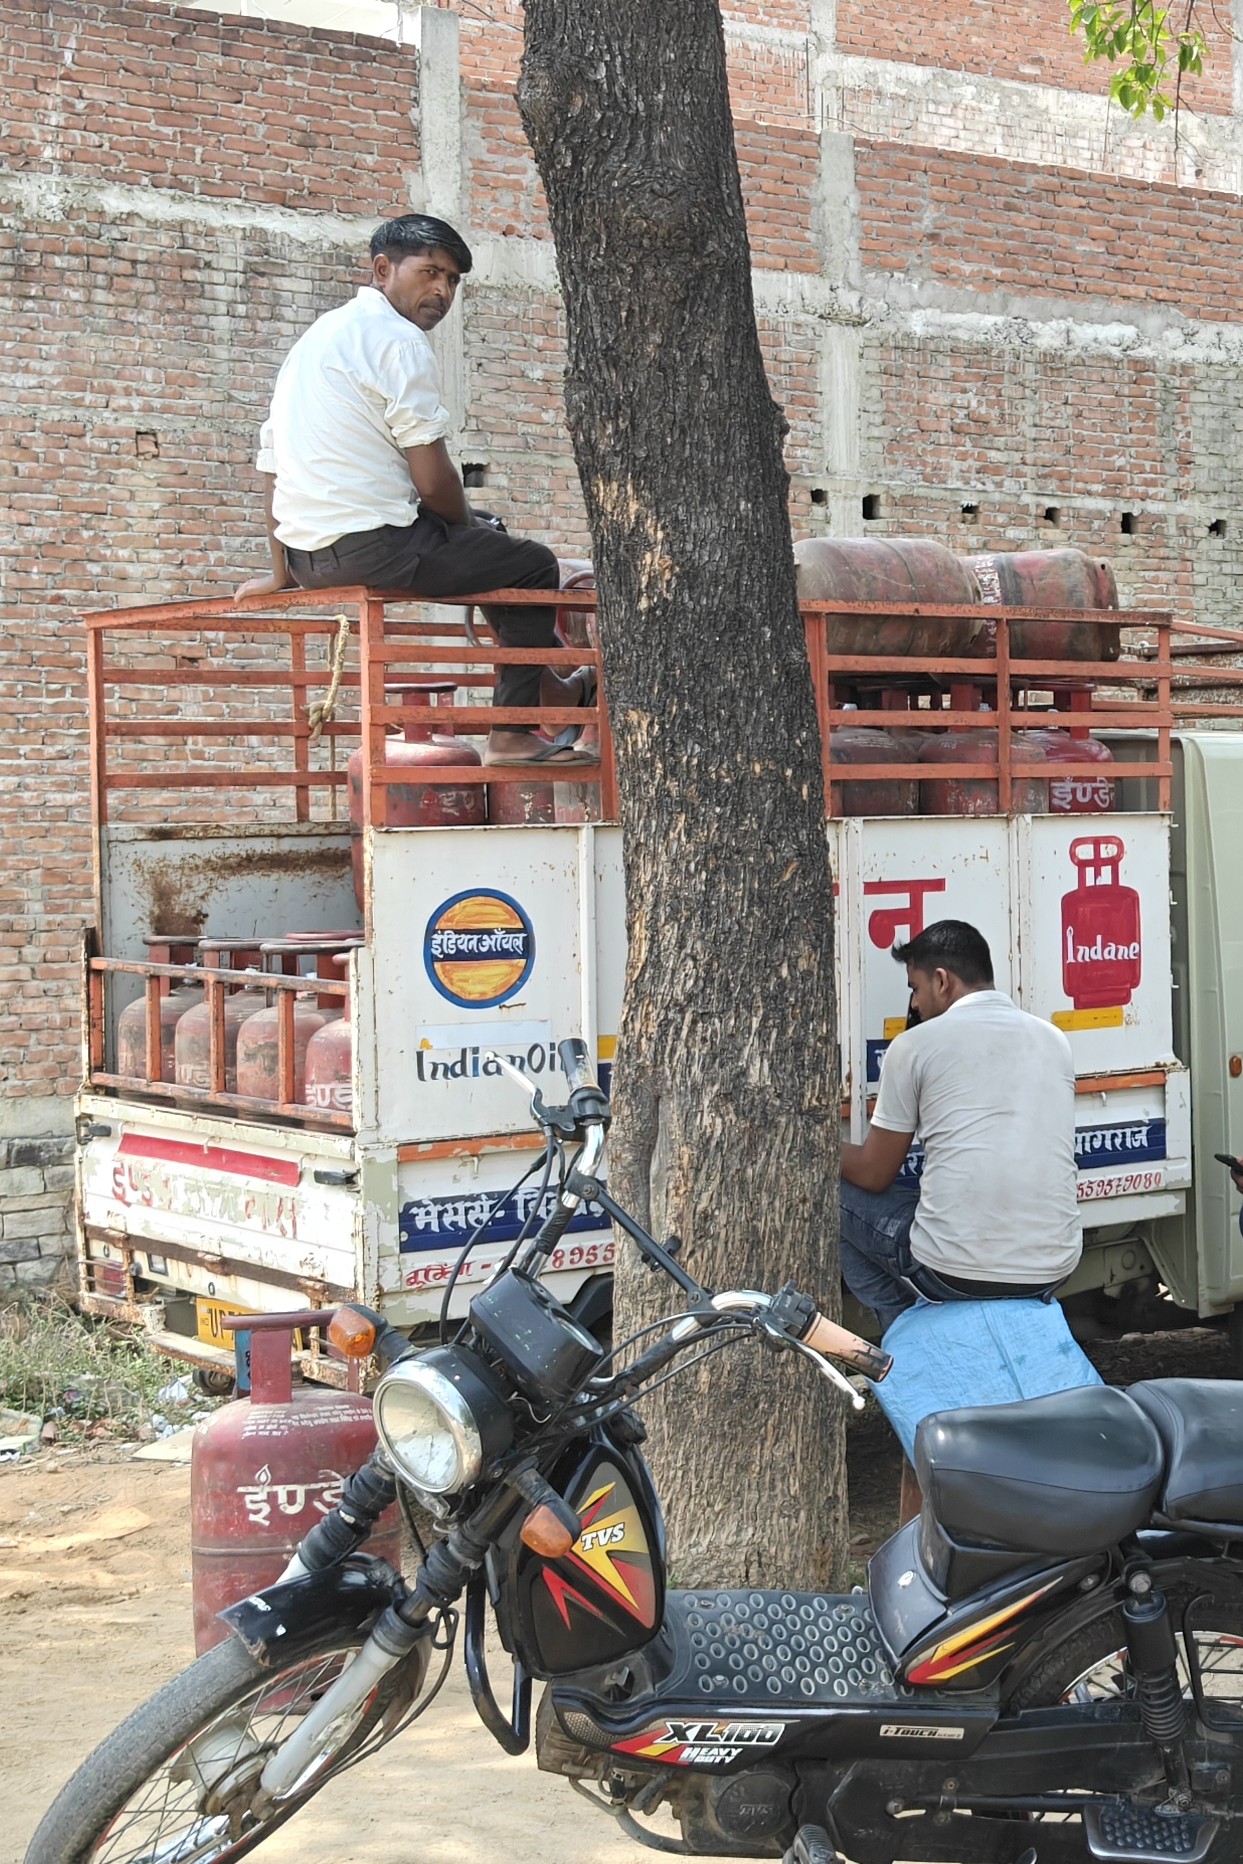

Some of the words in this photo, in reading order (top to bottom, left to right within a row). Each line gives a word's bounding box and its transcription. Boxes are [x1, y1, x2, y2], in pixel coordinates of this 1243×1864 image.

[1066, 926, 1140, 963] Indane
[416, 1043, 567, 1082] IndianOi
[581, 1522, 625, 1552] TVS
[678, 1747, 743, 1763] HEAVY
